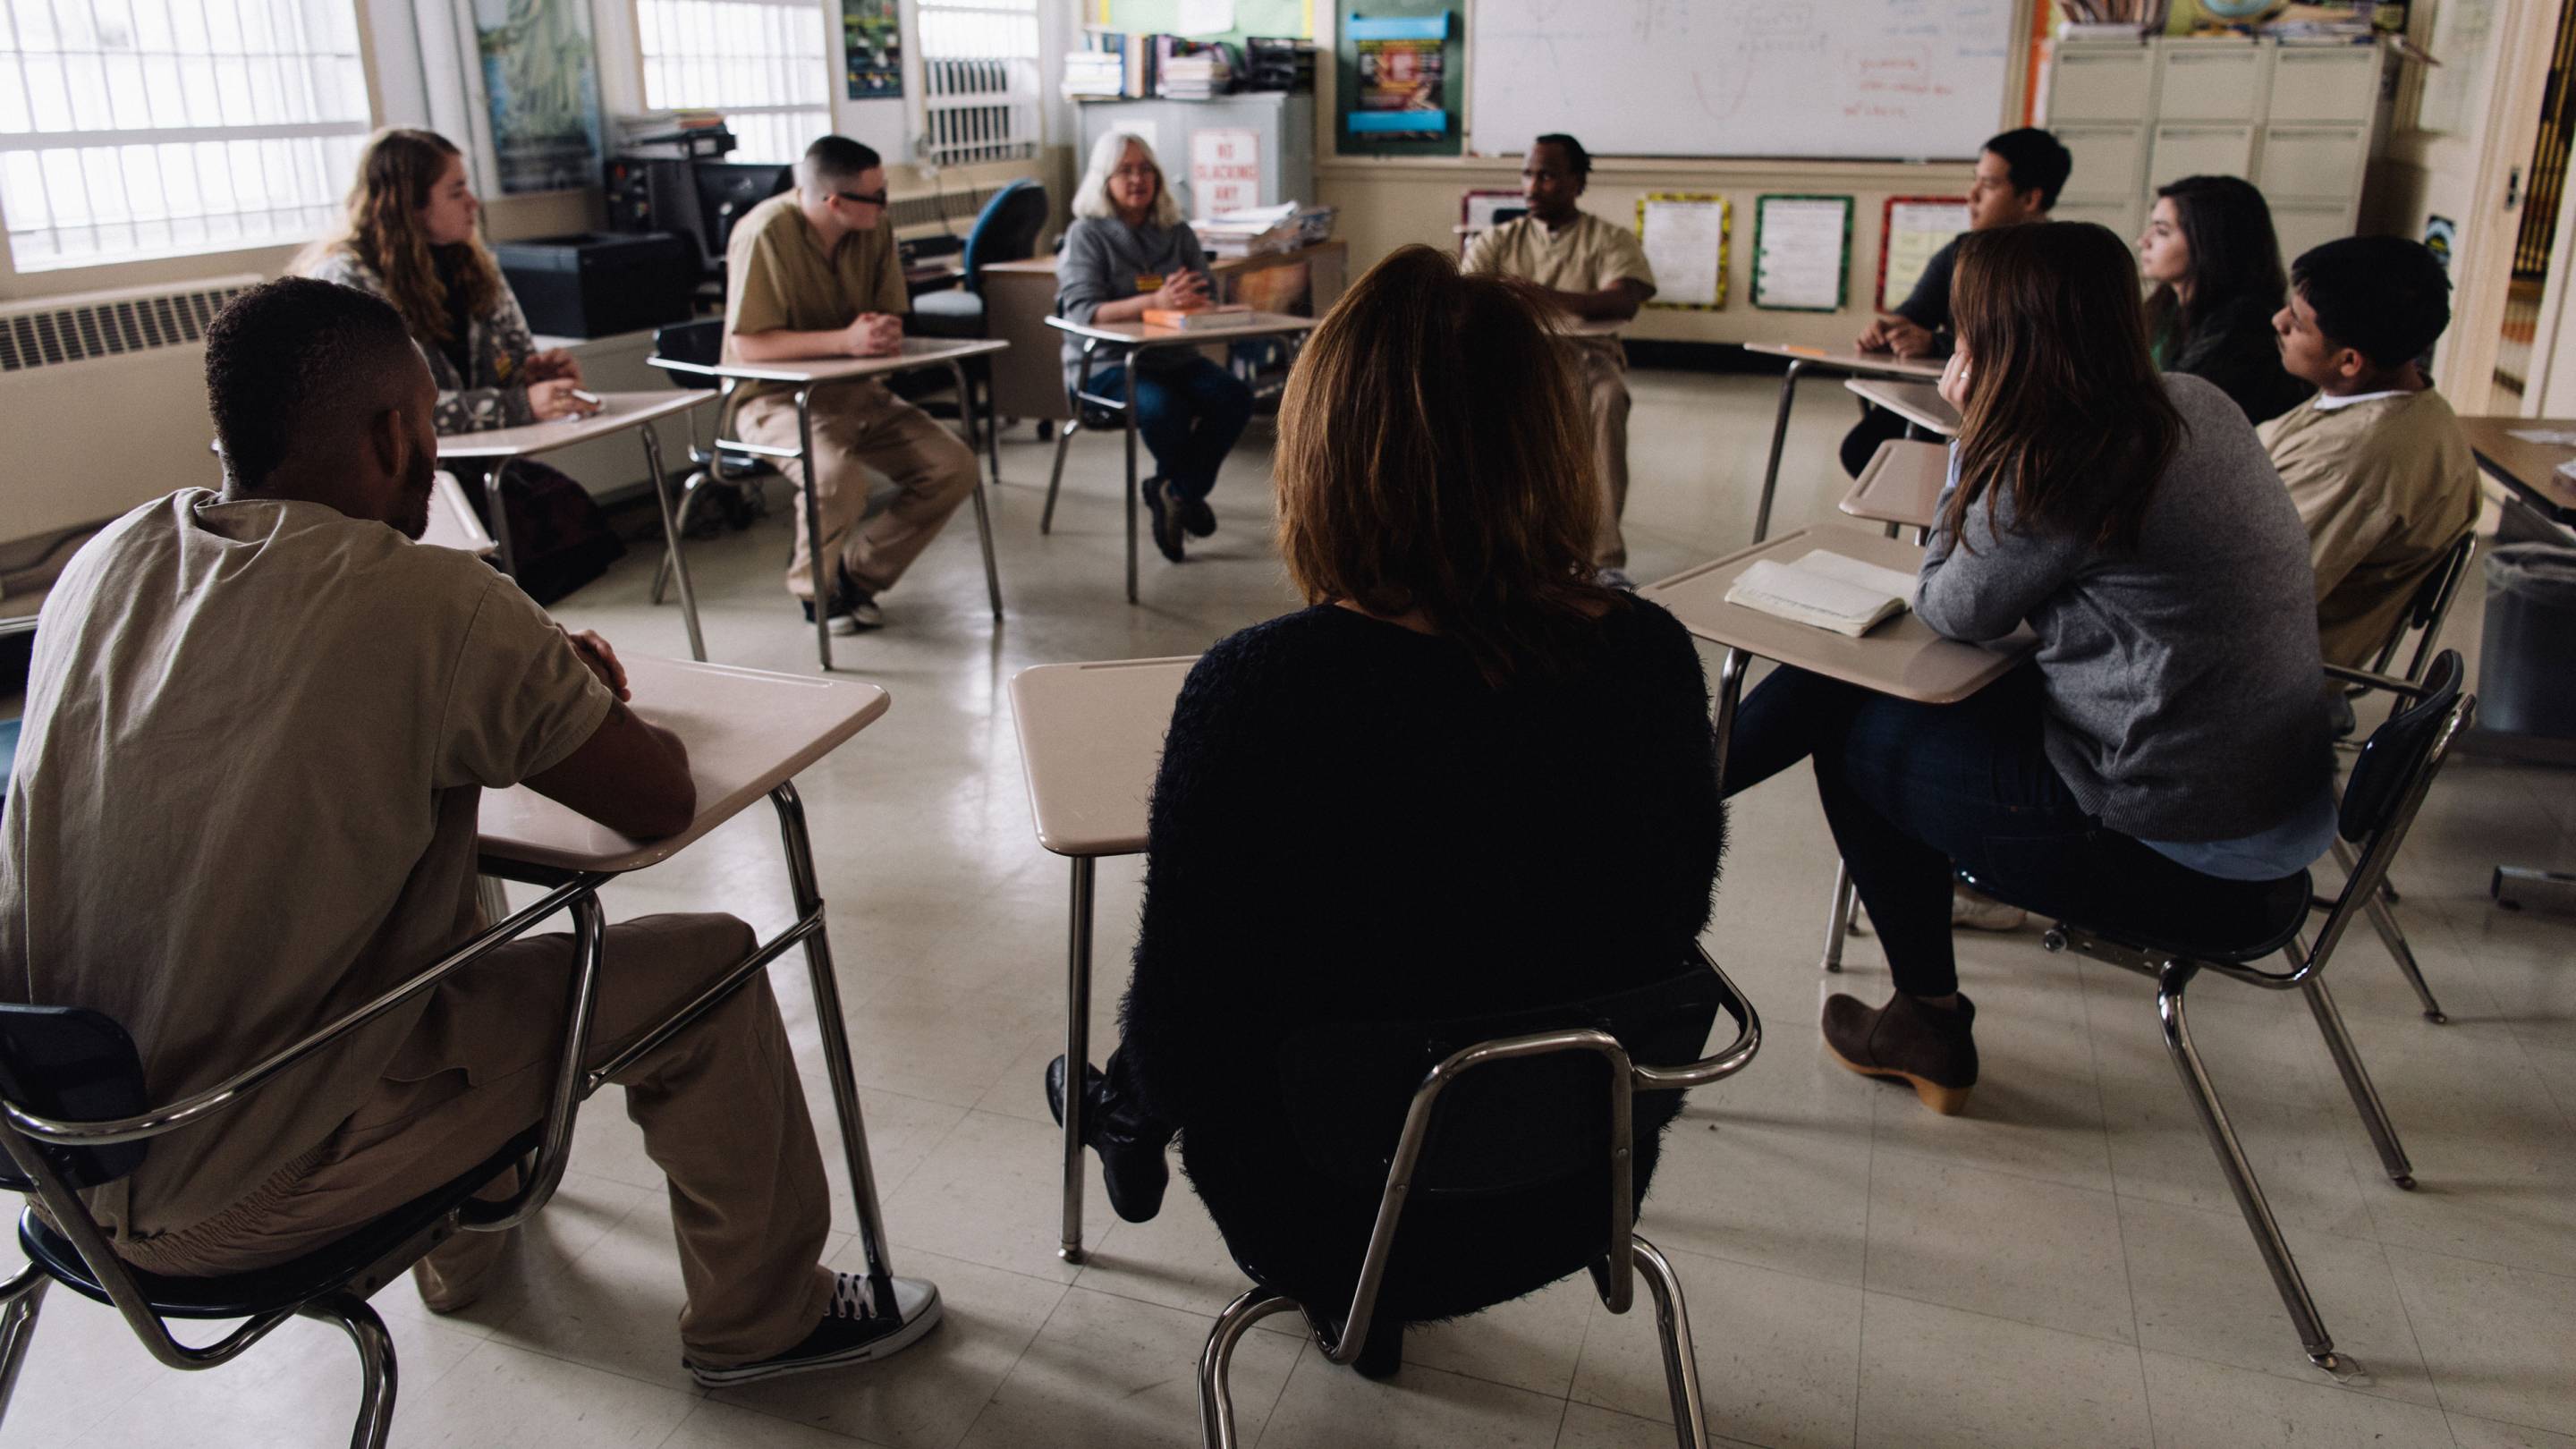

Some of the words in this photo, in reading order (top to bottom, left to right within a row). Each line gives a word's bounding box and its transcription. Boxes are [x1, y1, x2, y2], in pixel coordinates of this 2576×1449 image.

[1216, 143, 1233, 157] NO
[1195, 165, 1257, 179] SLACKING
[1215, 185, 1239, 199] ANY
